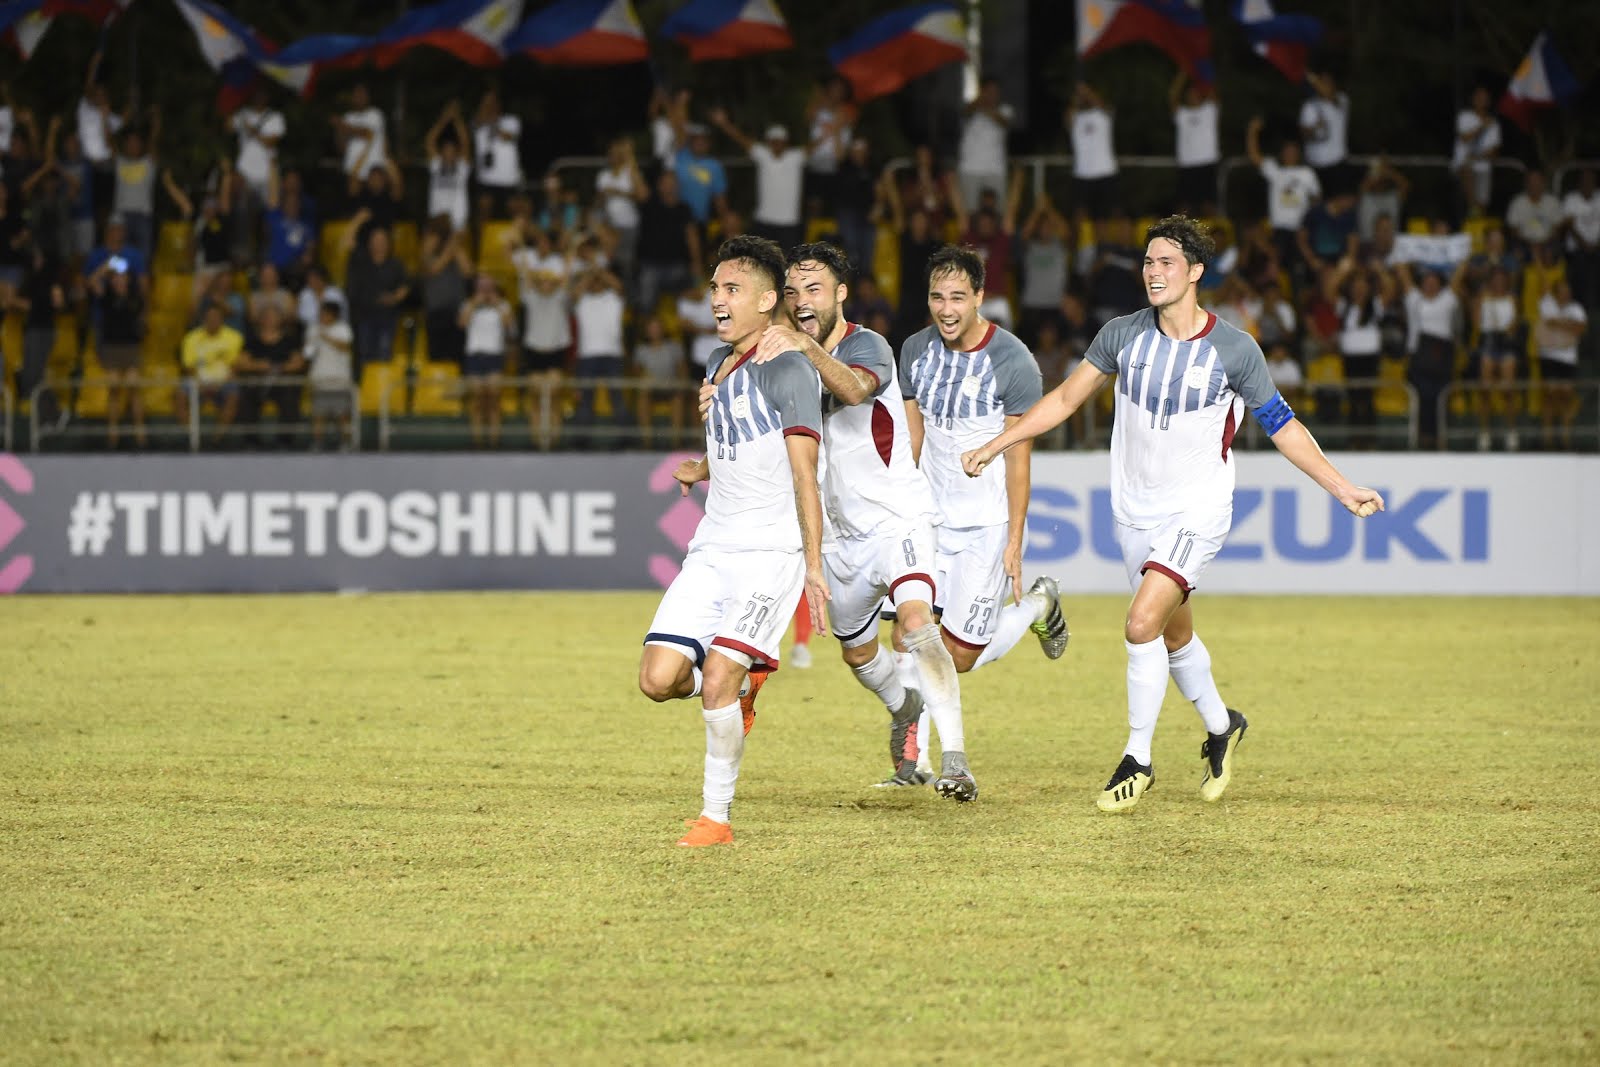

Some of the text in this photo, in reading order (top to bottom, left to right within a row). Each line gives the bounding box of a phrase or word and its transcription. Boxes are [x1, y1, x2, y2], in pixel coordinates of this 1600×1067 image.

[1150, 396, 1172, 431] 10
[716, 424, 737, 461] 29
[68, 491, 615, 556] #TIMETOSHINE
[901, 538, 917, 567] 8
[1168, 532, 1194, 570] 10
[734, 600, 769, 640] 29
[962, 603, 993, 637] 23
